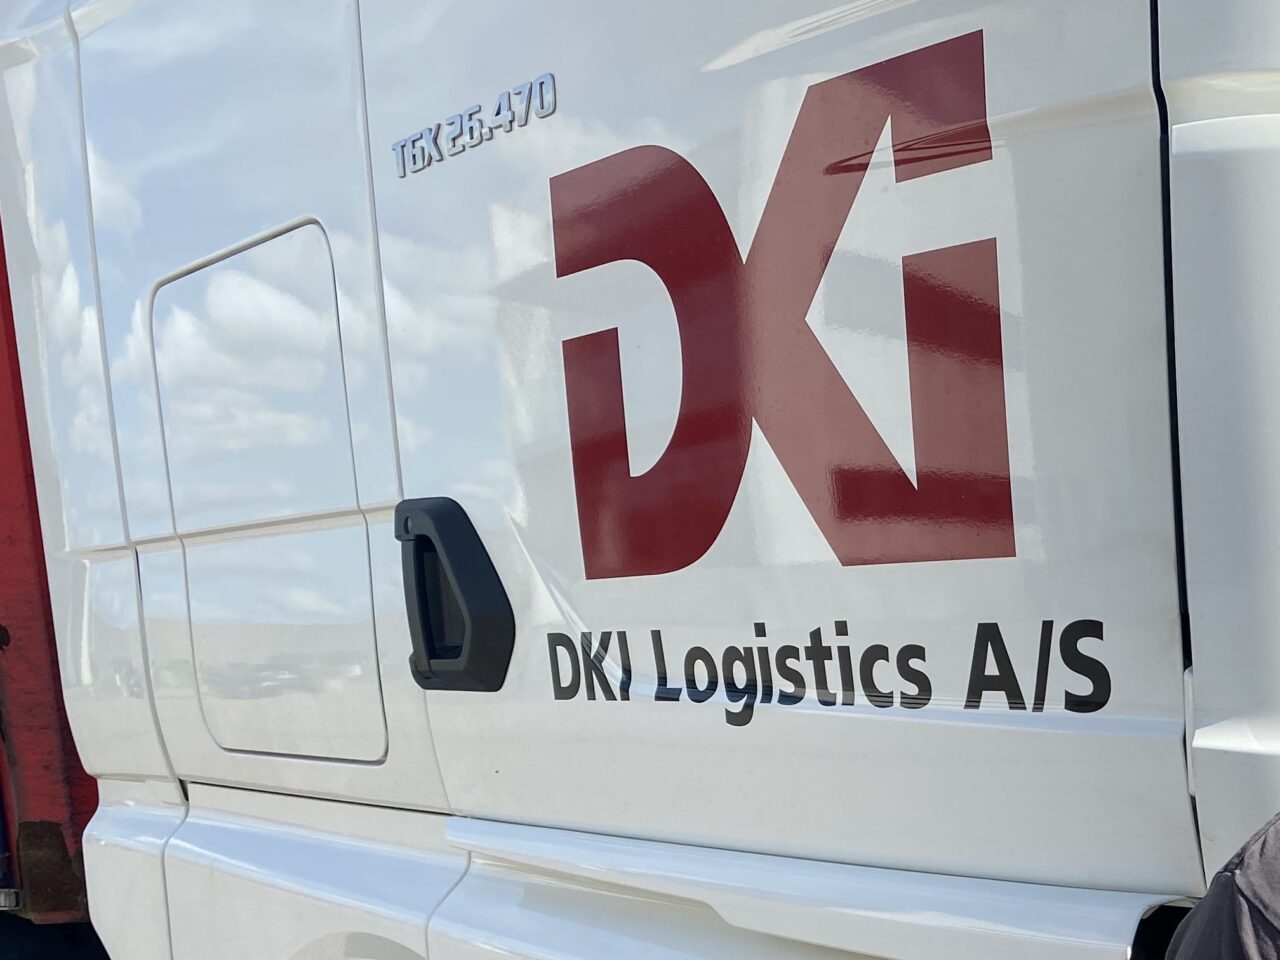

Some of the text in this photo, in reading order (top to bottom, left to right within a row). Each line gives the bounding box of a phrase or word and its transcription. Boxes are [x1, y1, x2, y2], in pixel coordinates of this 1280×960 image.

[392, 72, 556, 179] TGX 26.470
[547, 619, 1112, 727] DKI Logistics A/S
